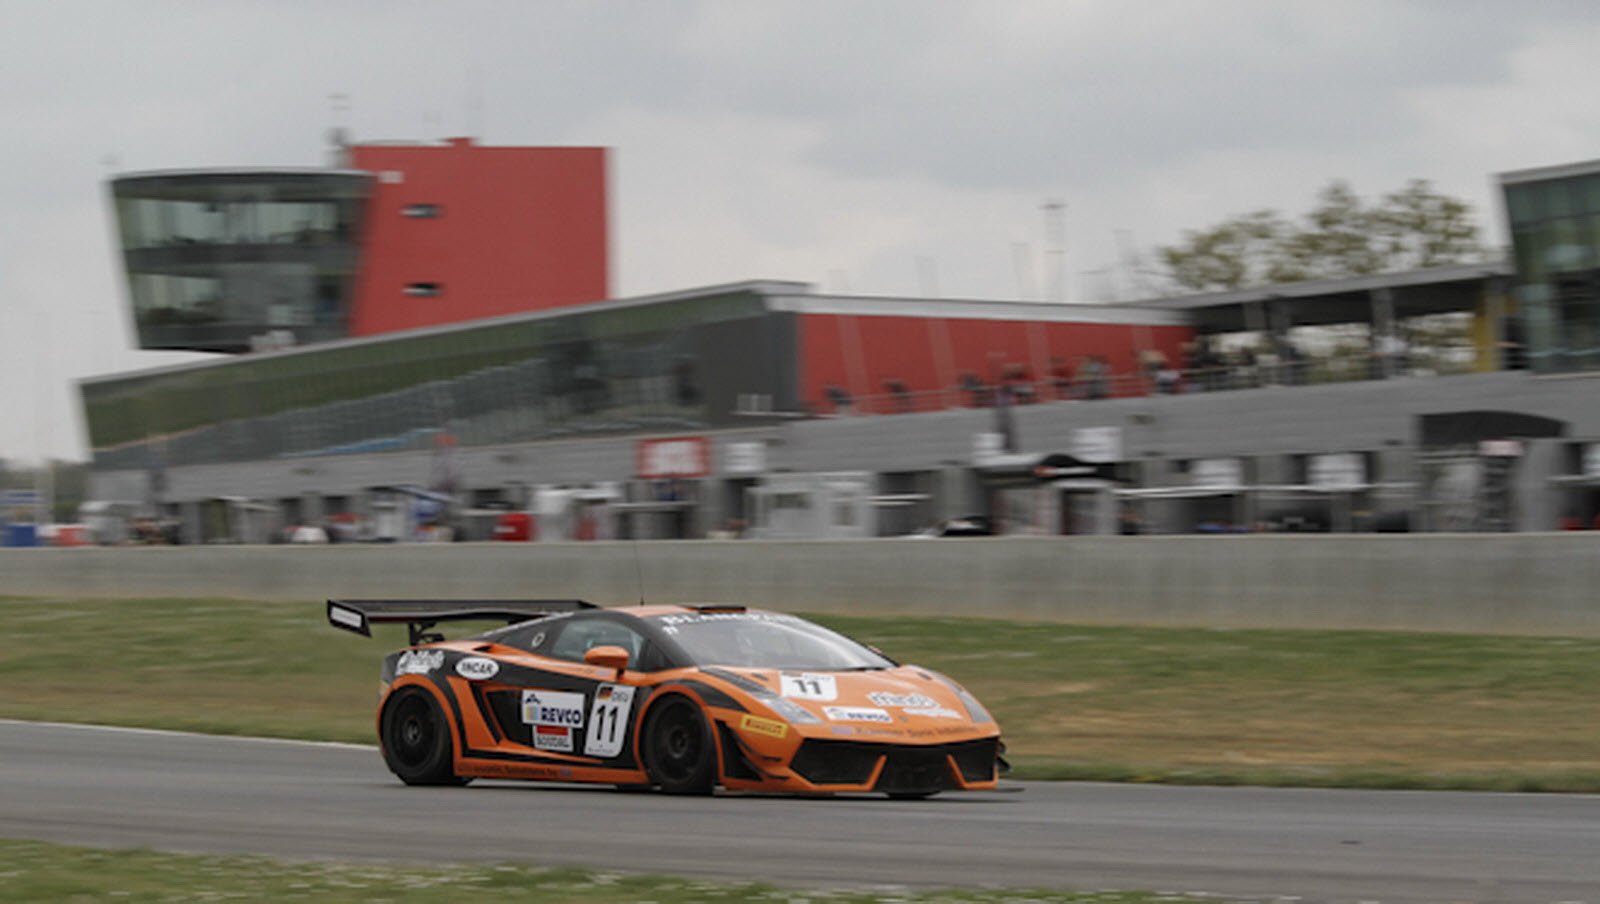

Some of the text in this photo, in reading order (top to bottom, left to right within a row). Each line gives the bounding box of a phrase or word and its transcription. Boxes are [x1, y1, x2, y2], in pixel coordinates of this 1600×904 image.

[460, 662, 494, 674] INCAR
[794, 679, 822, 695] 11
[541, 707, 582, 724] REVCO
[596, 704, 619, 743] 11
